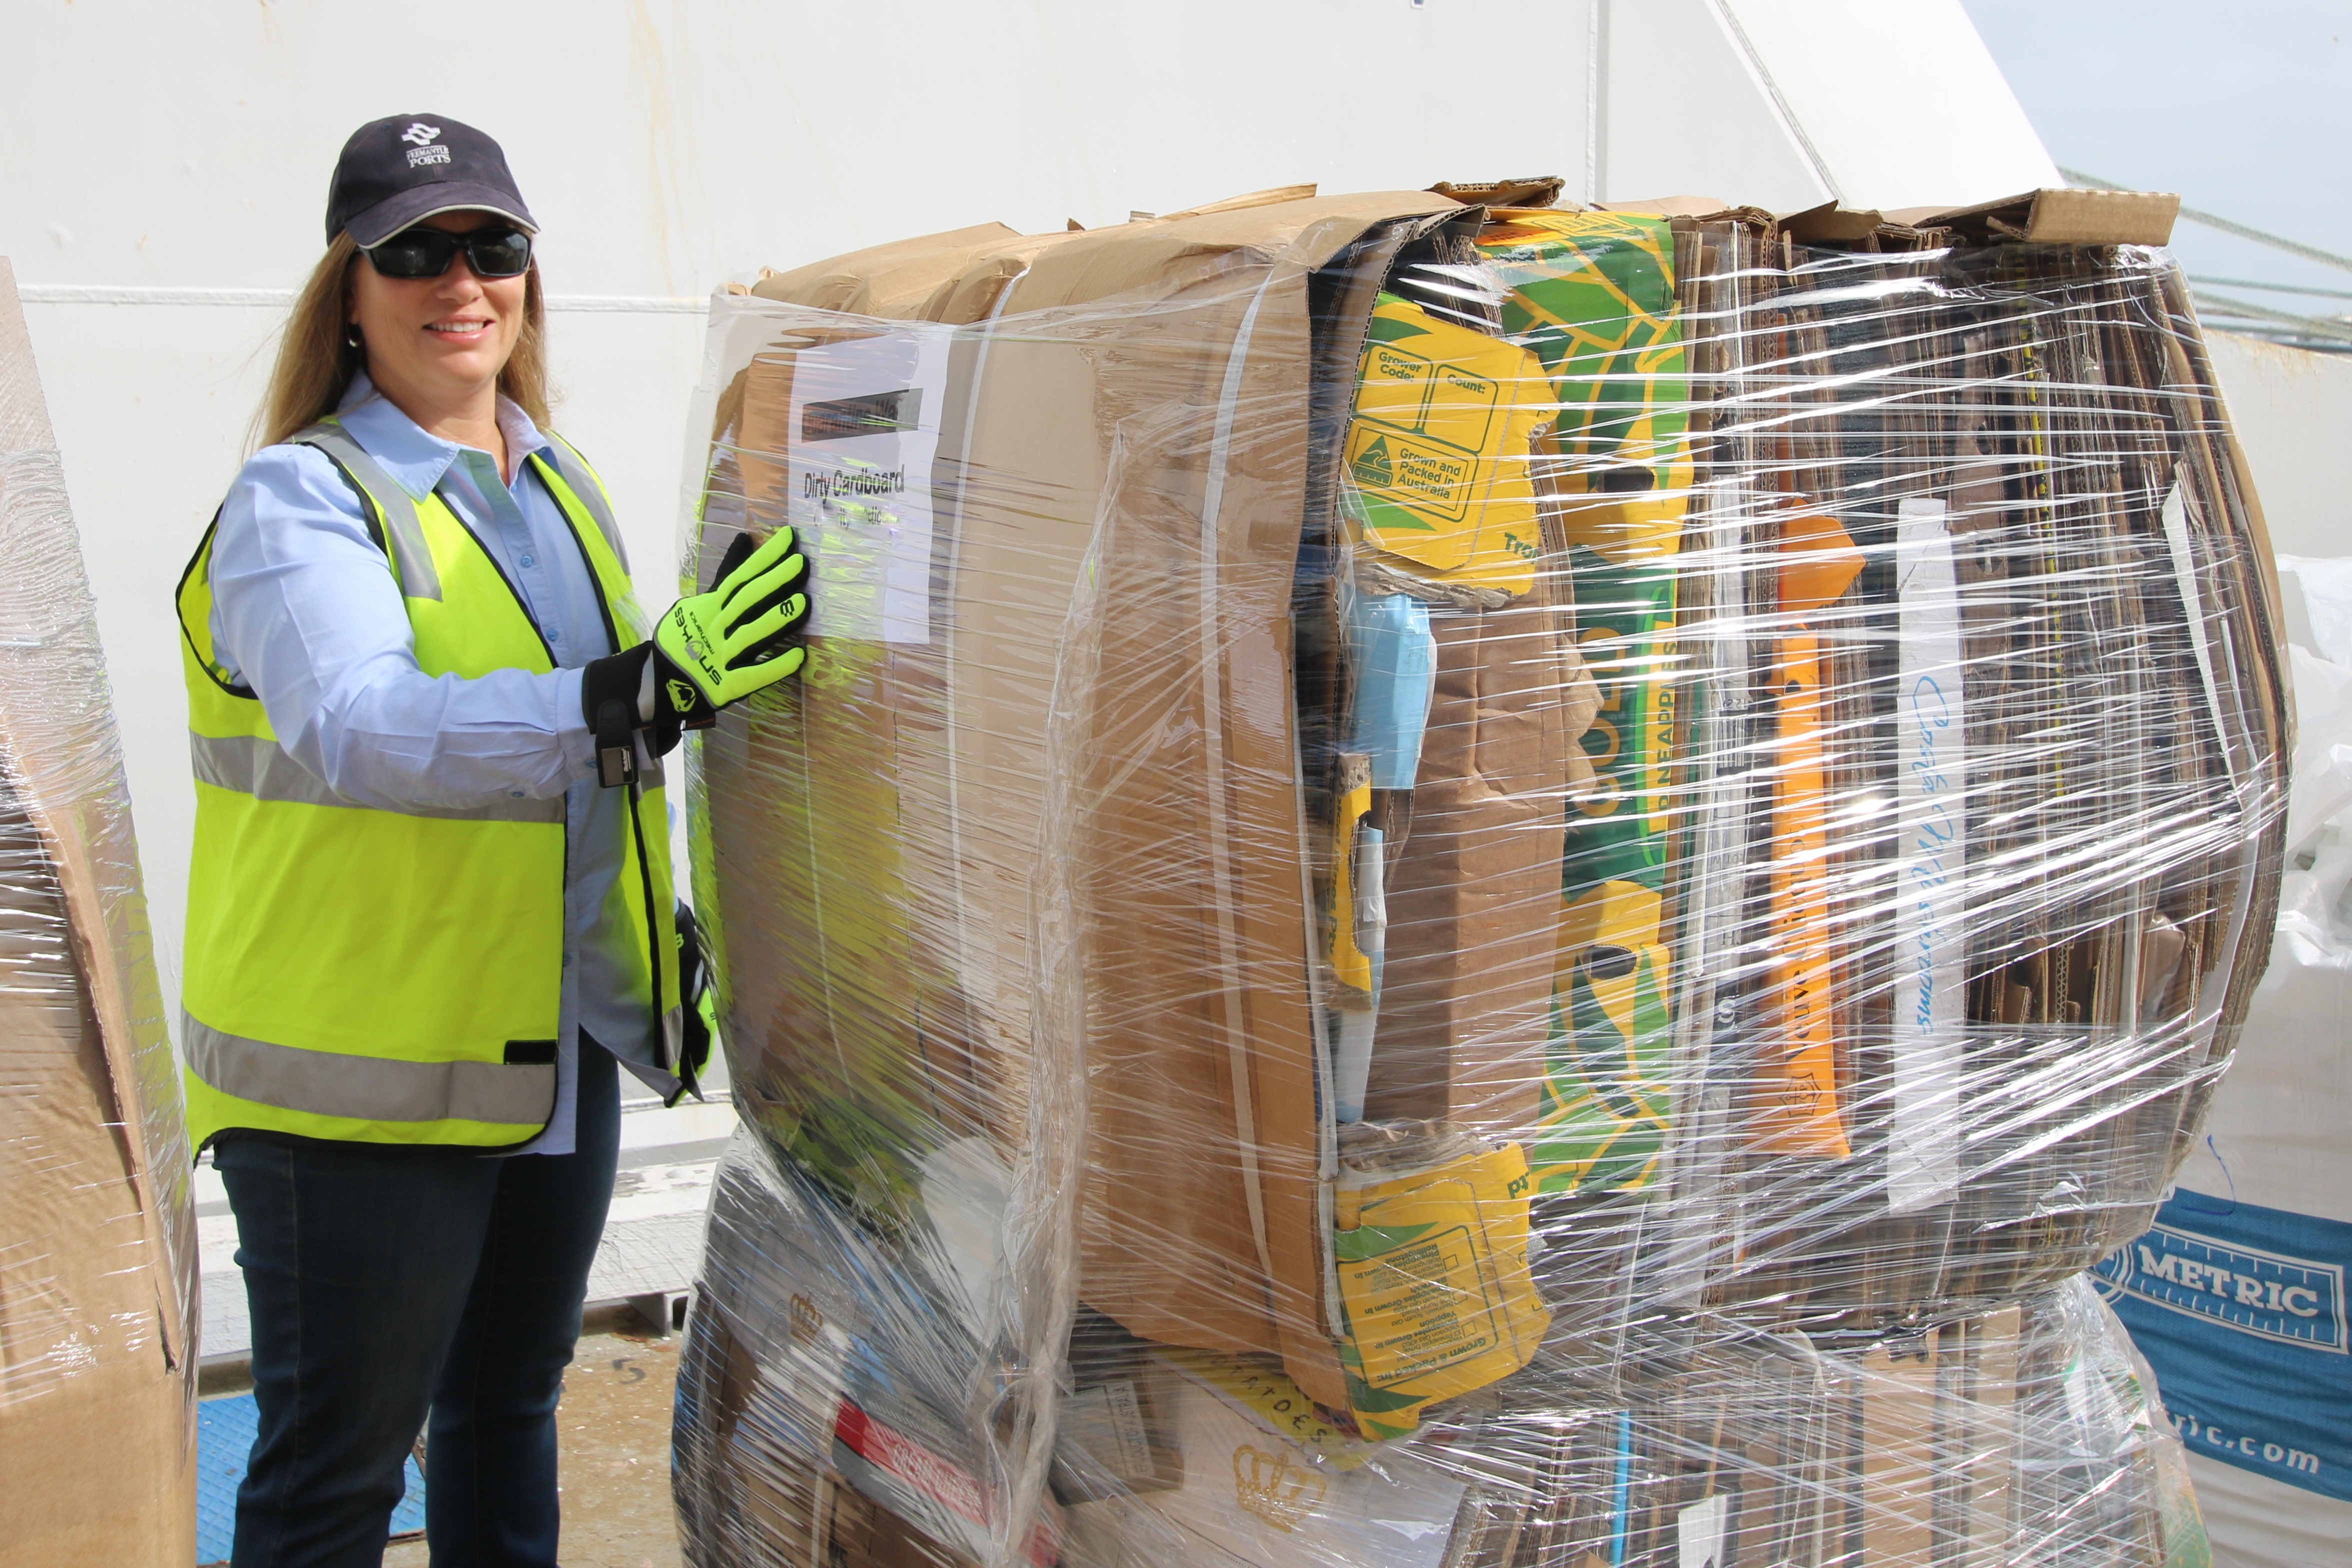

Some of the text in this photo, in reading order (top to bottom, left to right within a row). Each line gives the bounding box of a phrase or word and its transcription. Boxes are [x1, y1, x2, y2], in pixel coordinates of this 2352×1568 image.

[406, 146, 450, 160] FREMANTLE
[409, 154, 451, 168] PORTS
[1378, 352, 1422, 374] Grower
[1379, 364, 1415, 382] Code:
[1447, 374, 1486, 394] Count:
[1399, 461, 1455, 488] Packed in
[1400, 448, 1461, 476] Grown and
[804, 464, 905, 504] Dirty Cardboard
[1397, 474, 1451, 499] Australia
[2138, 1244, 2318, 1318] METRIC
[2166, 1411, 2319, 1474] ric.com
